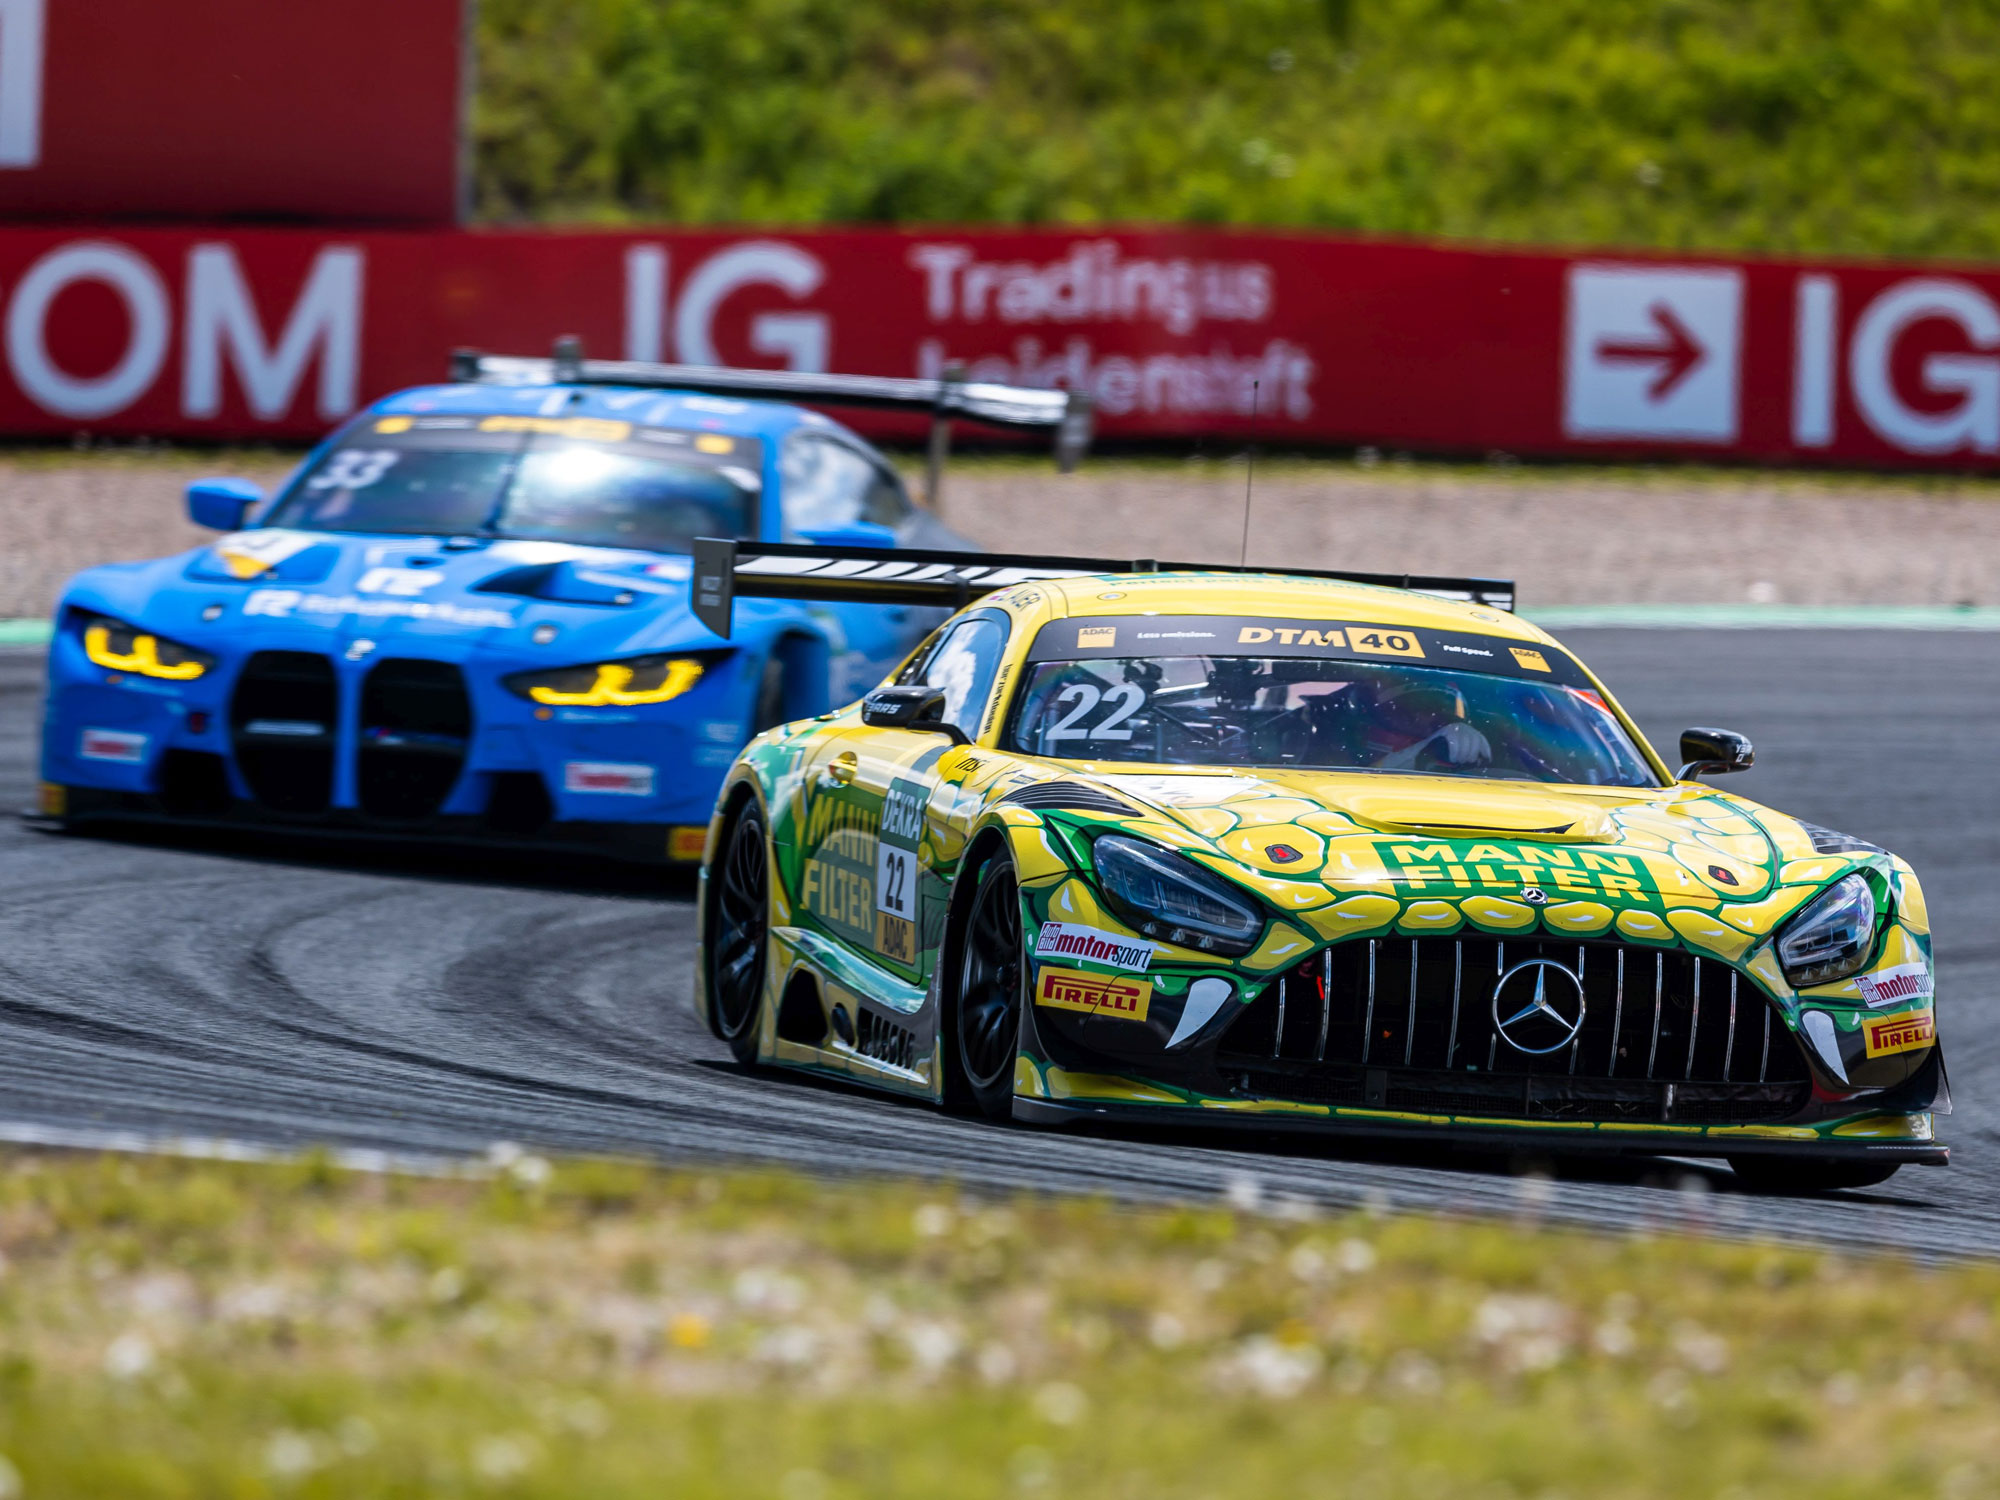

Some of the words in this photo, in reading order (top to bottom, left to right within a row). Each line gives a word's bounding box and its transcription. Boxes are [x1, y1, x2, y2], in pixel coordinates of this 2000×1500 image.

[625, 241, 830, 372] IG
[911, 241, 1197, 335] Trading
[1793, 275, 2000, 456] IG
[1081, 628, 1114, 636] ADAC
[1237, 627, 1347, 647] DTM
[1360, 633, 1410, 651] 40
[1045, 684, 1146, 741] 22
[808, 793, 877, 867] MANN
[882, 789, 922, 841] DEKRA
[885, 852, 905, 912] 22
[1390, 844, 1637, 876] MANN
[1402, 864, 1650, 902] FILTER
[802, 858, 873, 933] FILTER
[1043, 974, 1141, 1012] PIRELLI
[1871, 1016, 1933, 1050] PIRELLI
